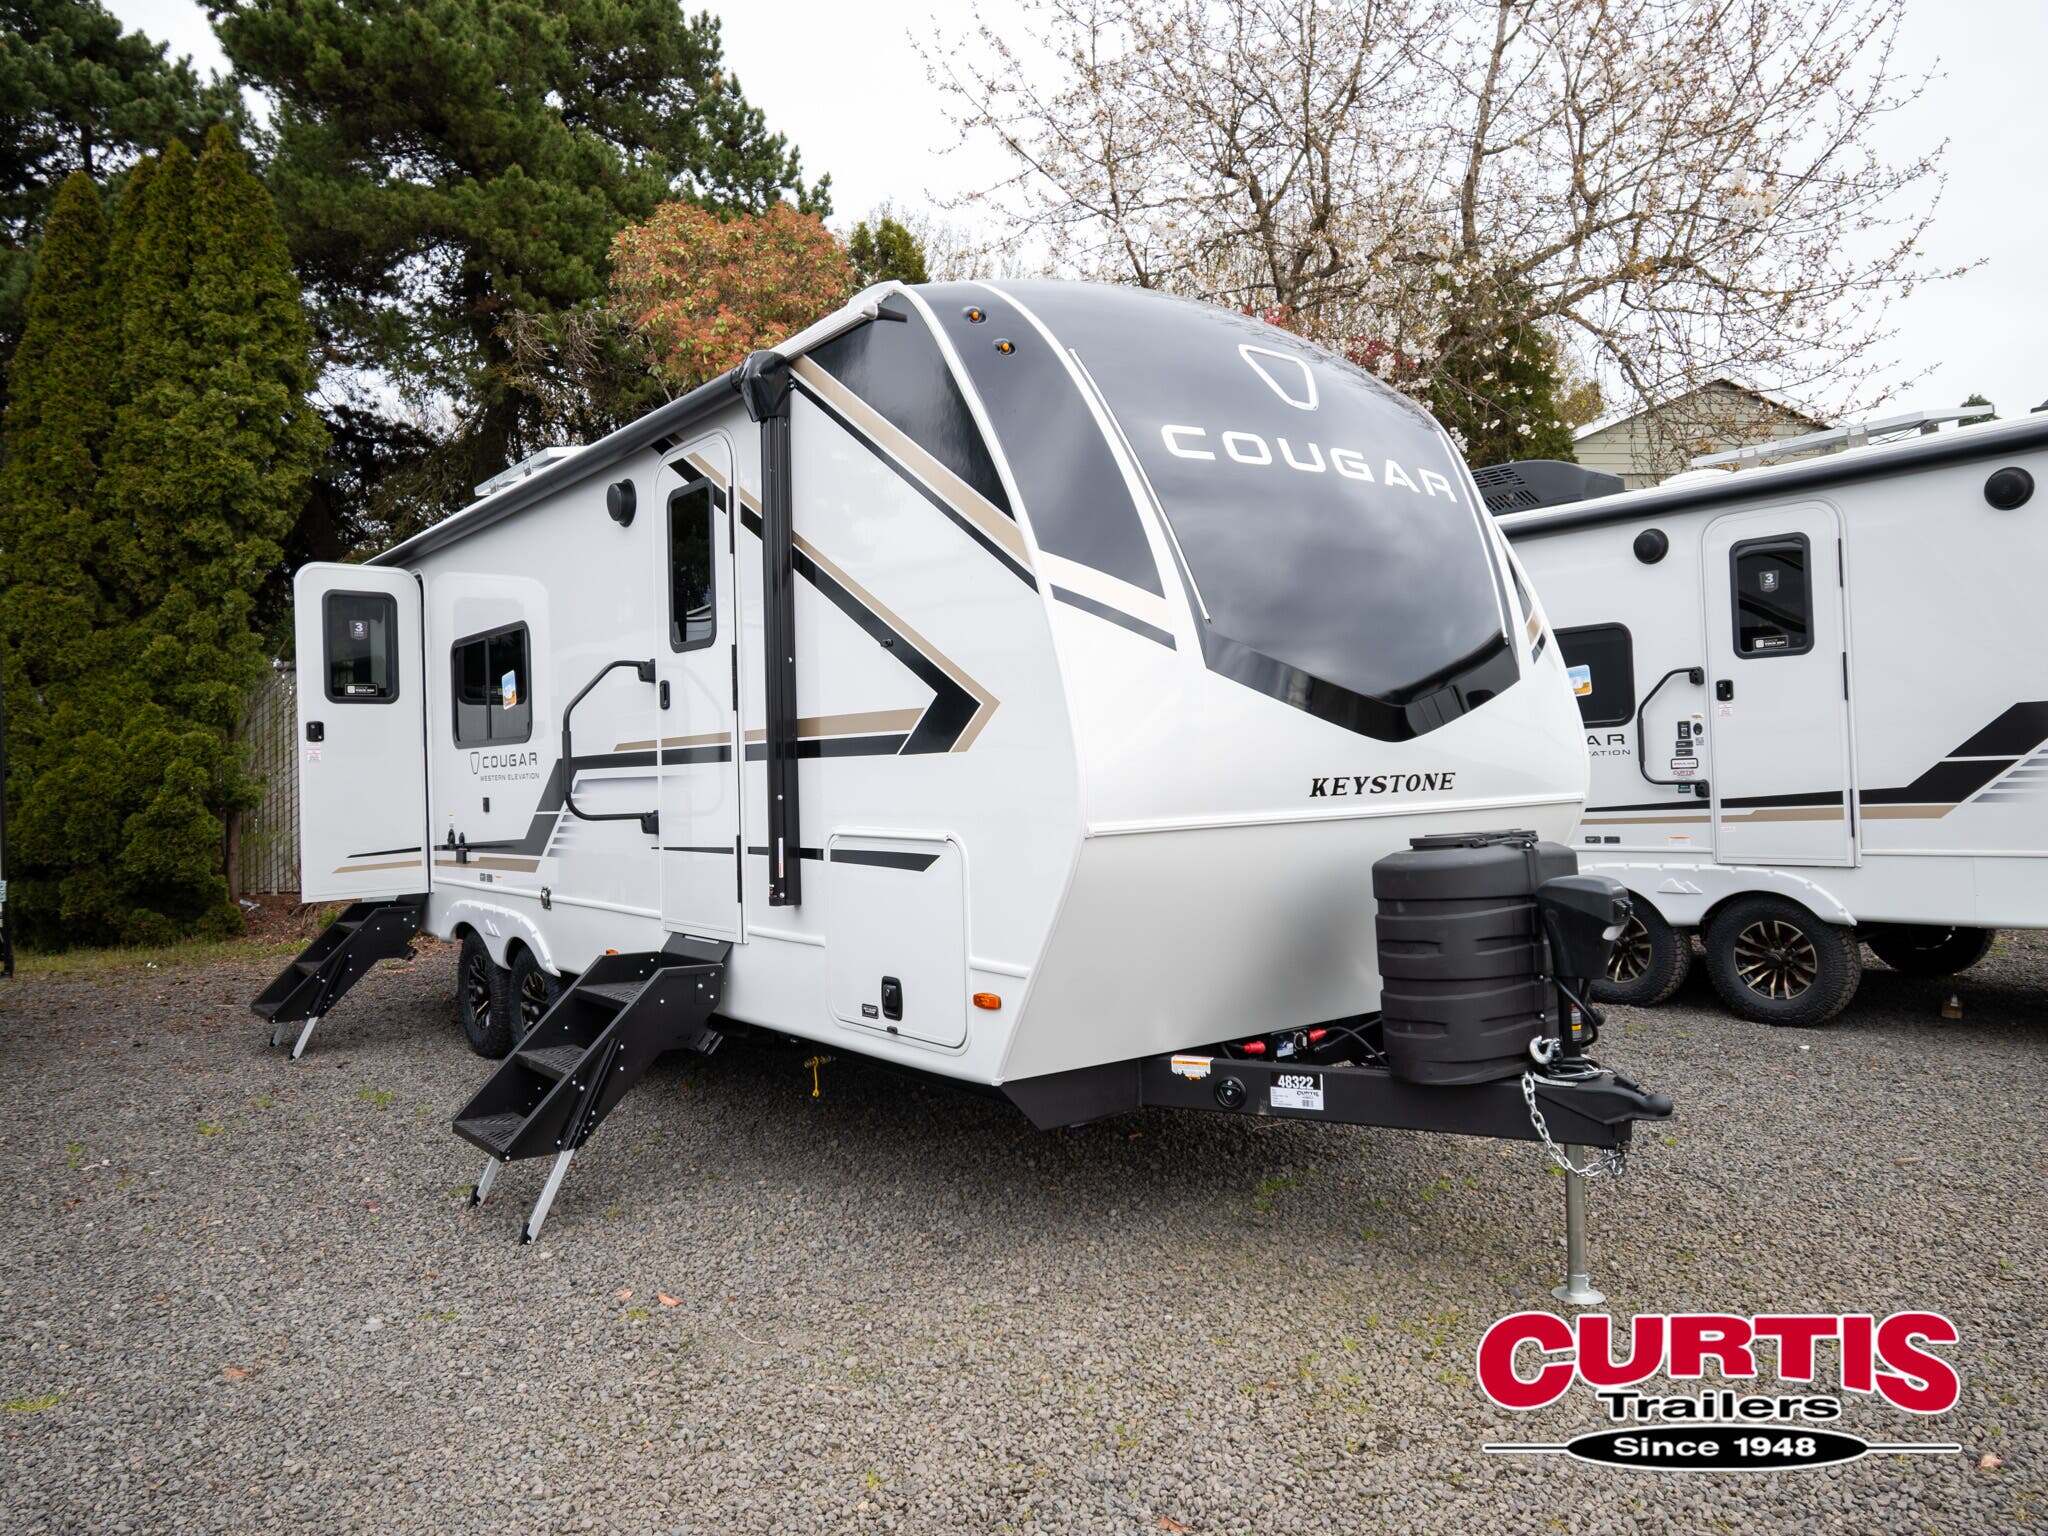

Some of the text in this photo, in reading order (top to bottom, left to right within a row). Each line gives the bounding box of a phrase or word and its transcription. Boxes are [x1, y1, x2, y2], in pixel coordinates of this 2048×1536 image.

[1160, 423, 1458, 503] COUGAR
[1764, 573, 1774, 583] 3
[354, 622, 364, 631] 3
[482, 752, 538, 768] COUGAR
[480, 772, 540, 782] WESTERN ELEVATION
[1309, 772, 1456, 798] KEYSTONE
[1278, 1075, 1314, 1090] 48322
